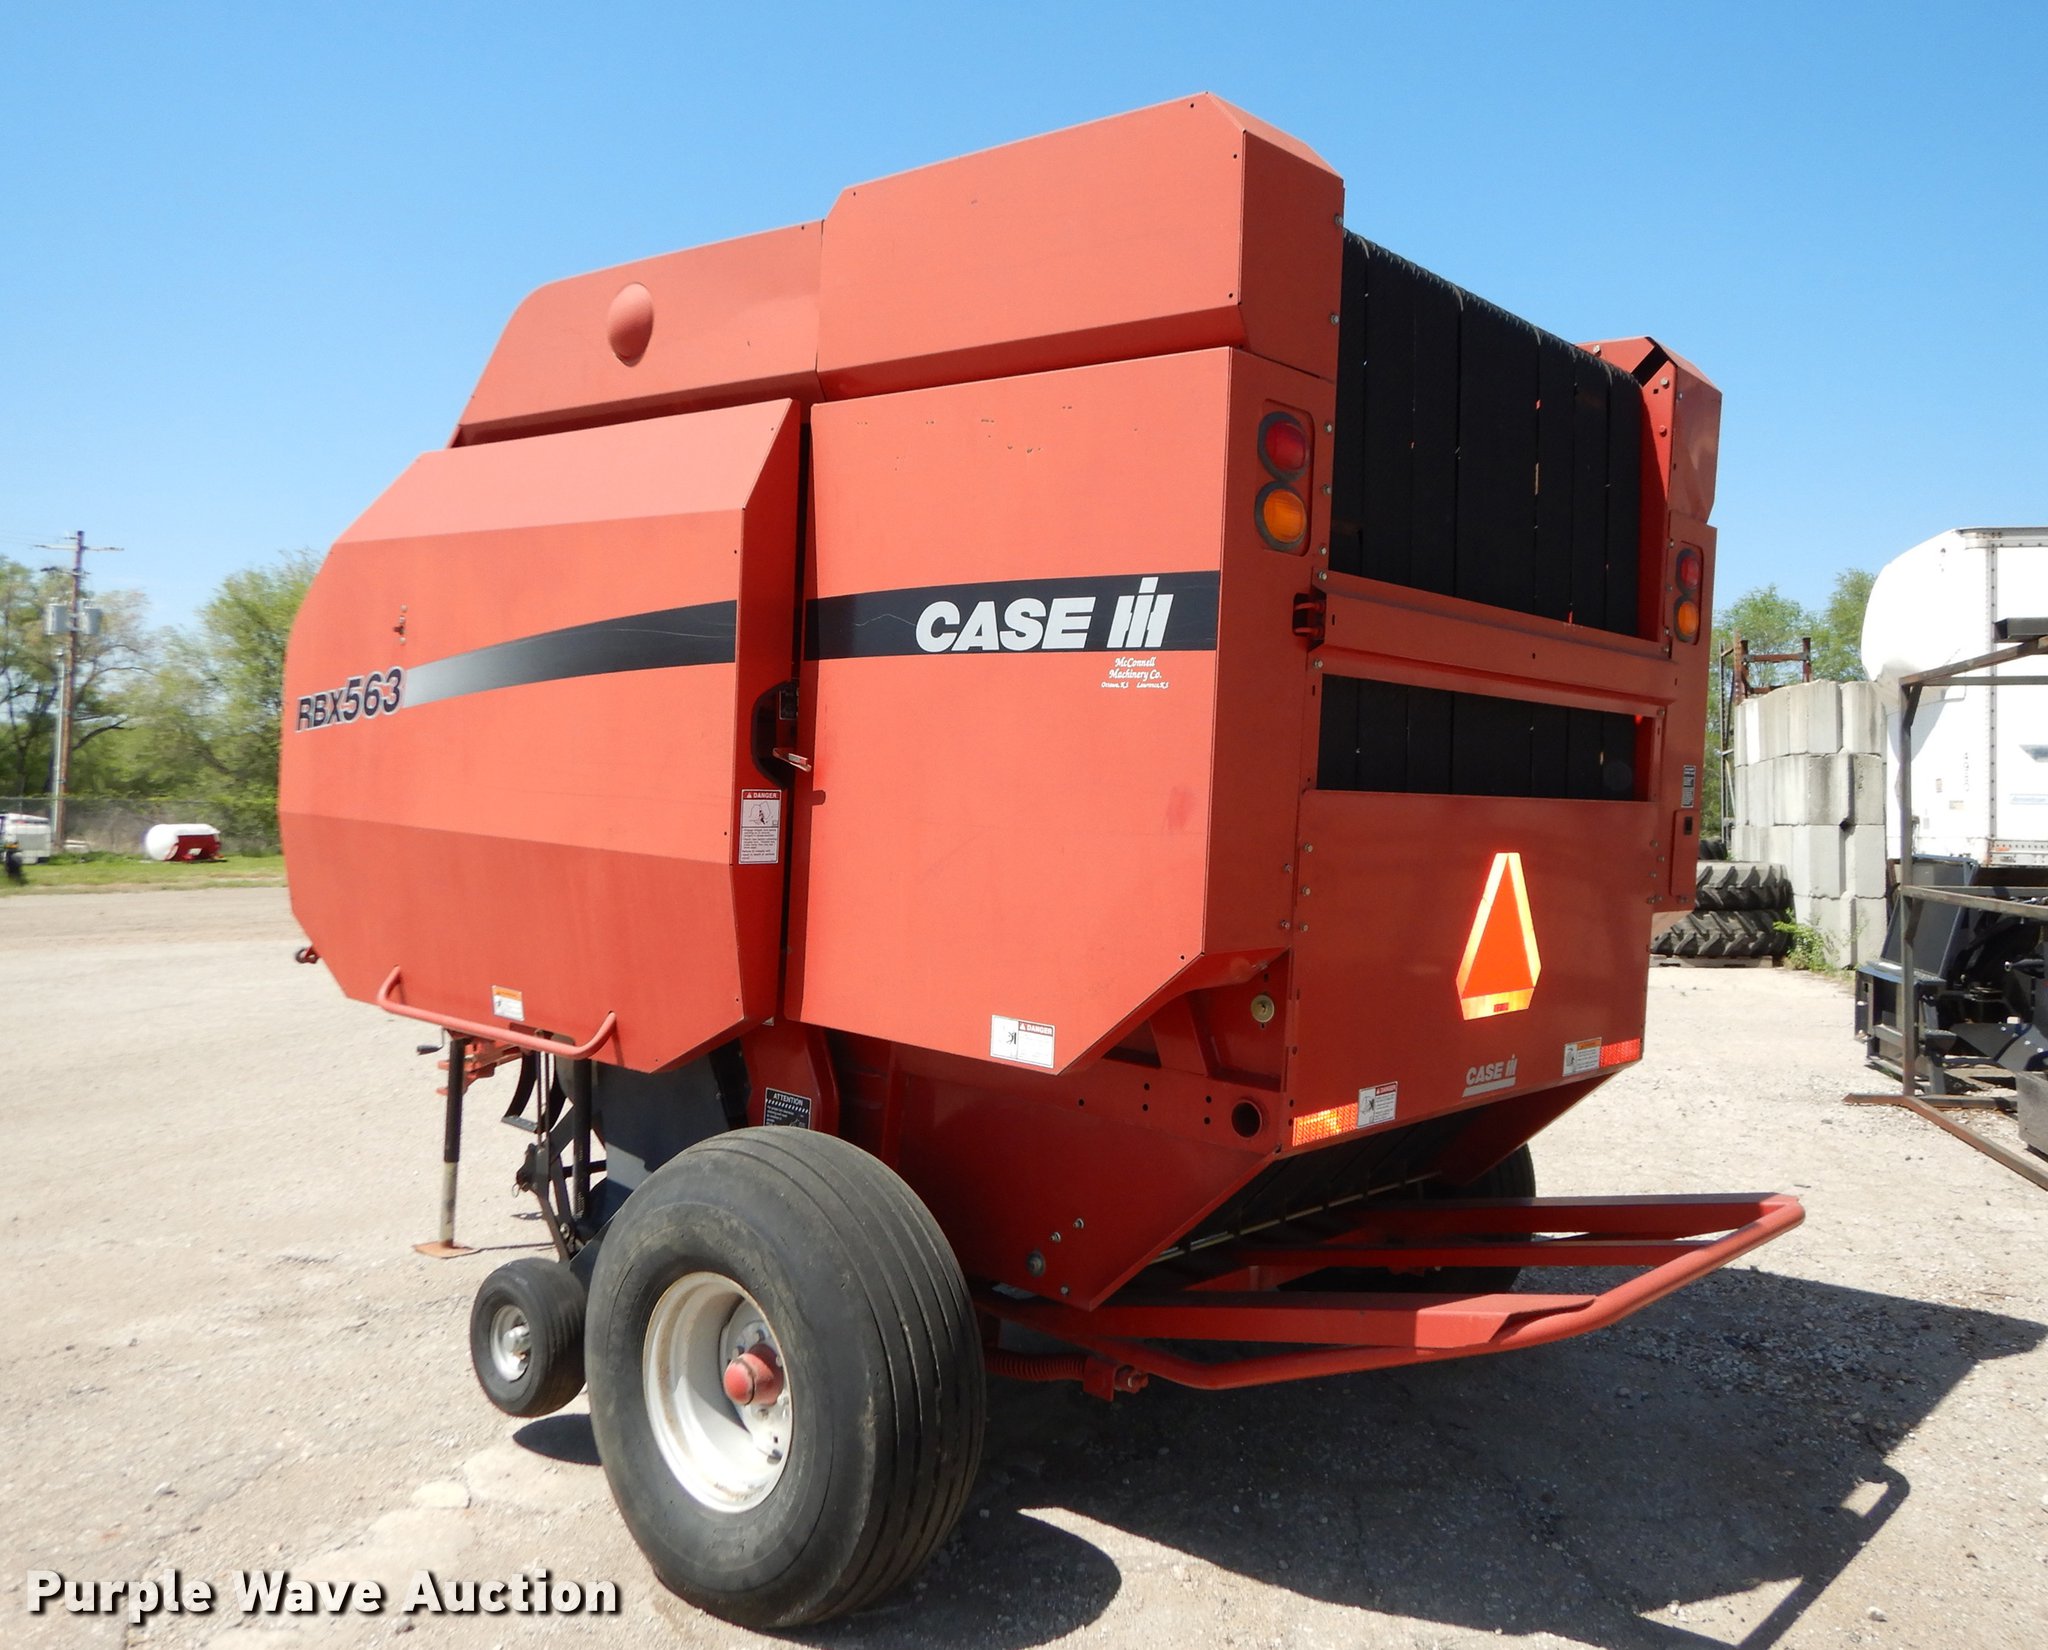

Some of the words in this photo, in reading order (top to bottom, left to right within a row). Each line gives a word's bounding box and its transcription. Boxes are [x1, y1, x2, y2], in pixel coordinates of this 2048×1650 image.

[915, 597, 1096, 652] CASE
[1115, 656, 1156, 668] McConnell
[1109, 668, 1149, 681] Machinery
[1149, 669, 1161, 679] Co.
[296, 667, 404, 732] RBX563
[1026, 1025, 1053, 1035] DANGER
[1466, 1061, 1504, 1086] CASE
[773, 1093, 804, 1106] ATTENTION
